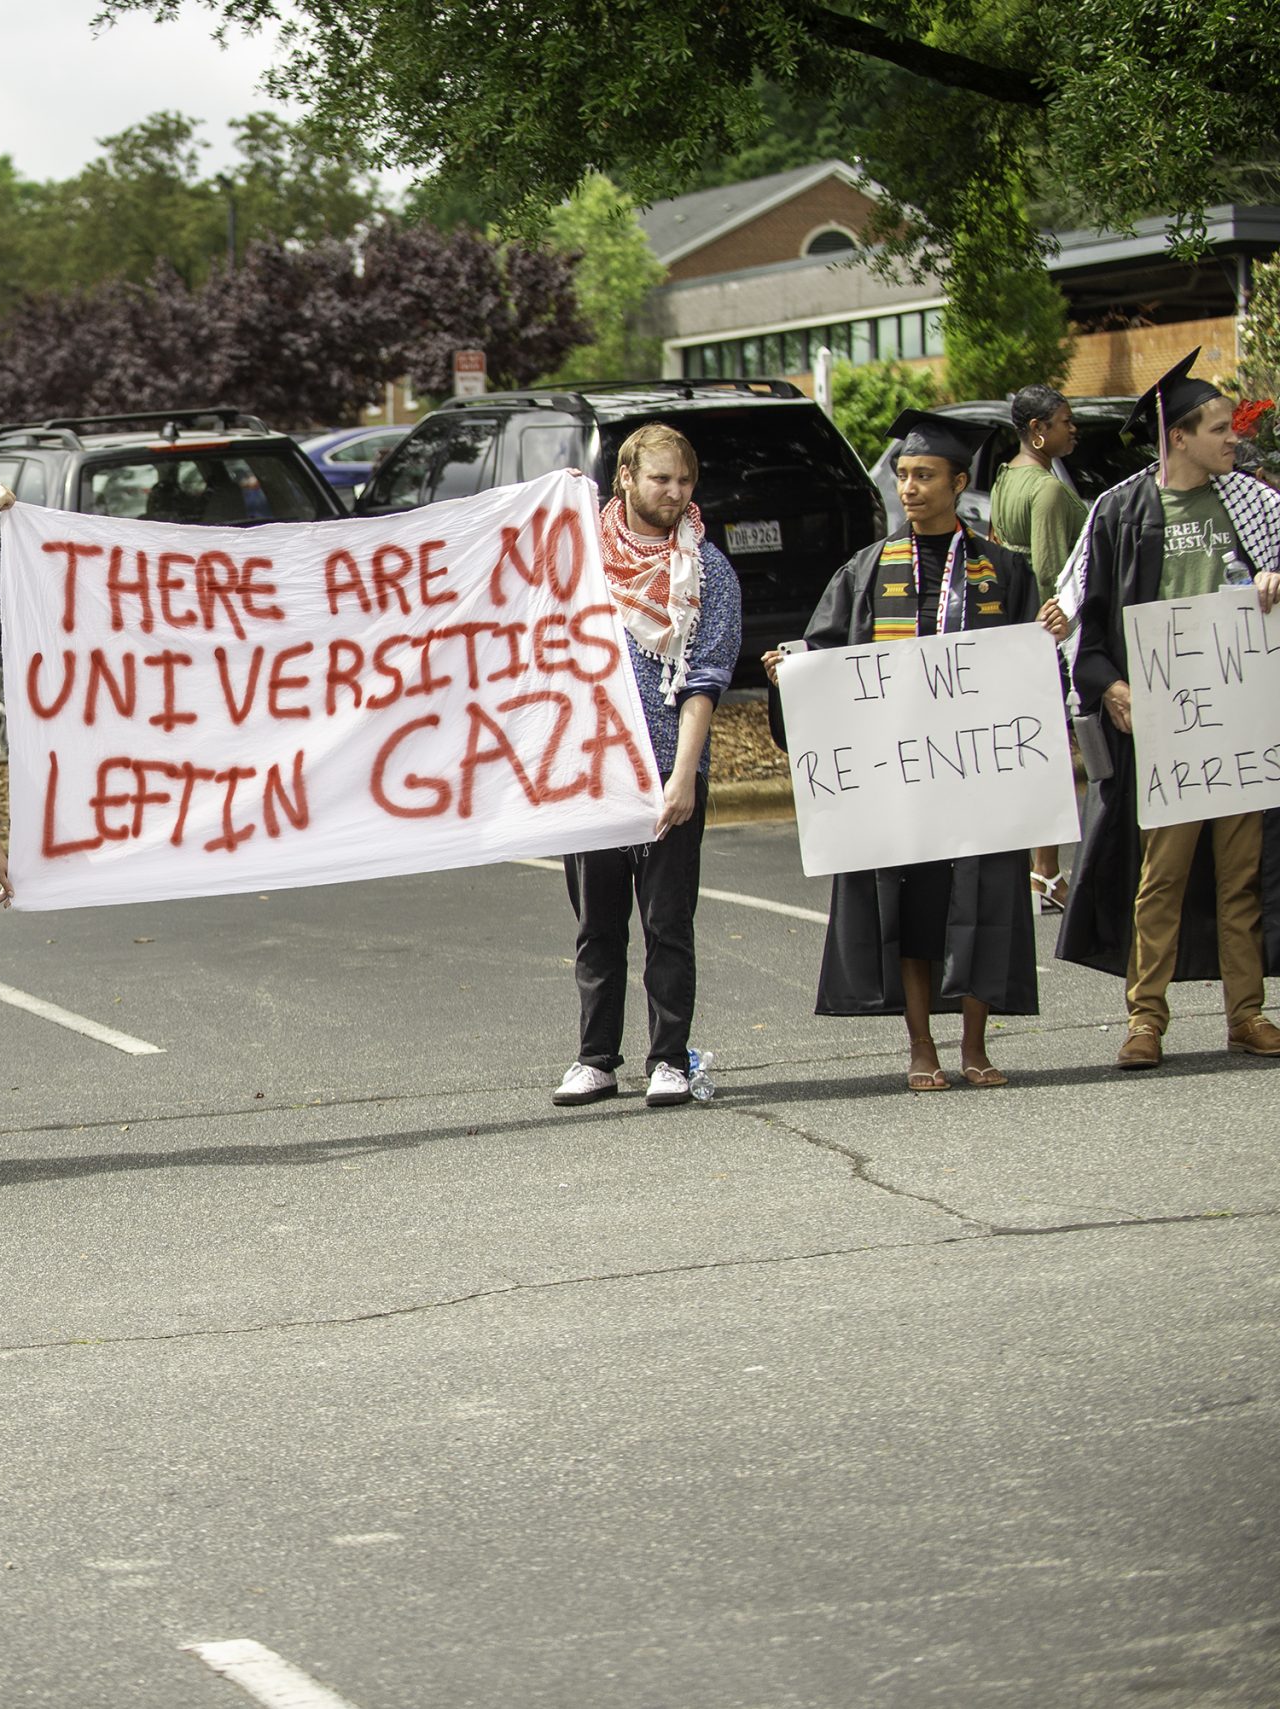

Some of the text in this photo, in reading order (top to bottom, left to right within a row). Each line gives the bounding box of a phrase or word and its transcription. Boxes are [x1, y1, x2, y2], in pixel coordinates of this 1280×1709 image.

[1164, 521, 1201, 538] FREE
[42, 507, 584, 639] THERE ARE NO
[27, 604, 621, 732] UNIVERSITIES
[845, 642, 979, 701] IF WE
[1134, 607, 1204, 692] WE
[371, 684, 652, 819] GAZA
[1172, 687, 1223, 733] BE
[797, 716, 1048, 799] RE-ENTER
[1148, 744, 1280, 806] ARRES
